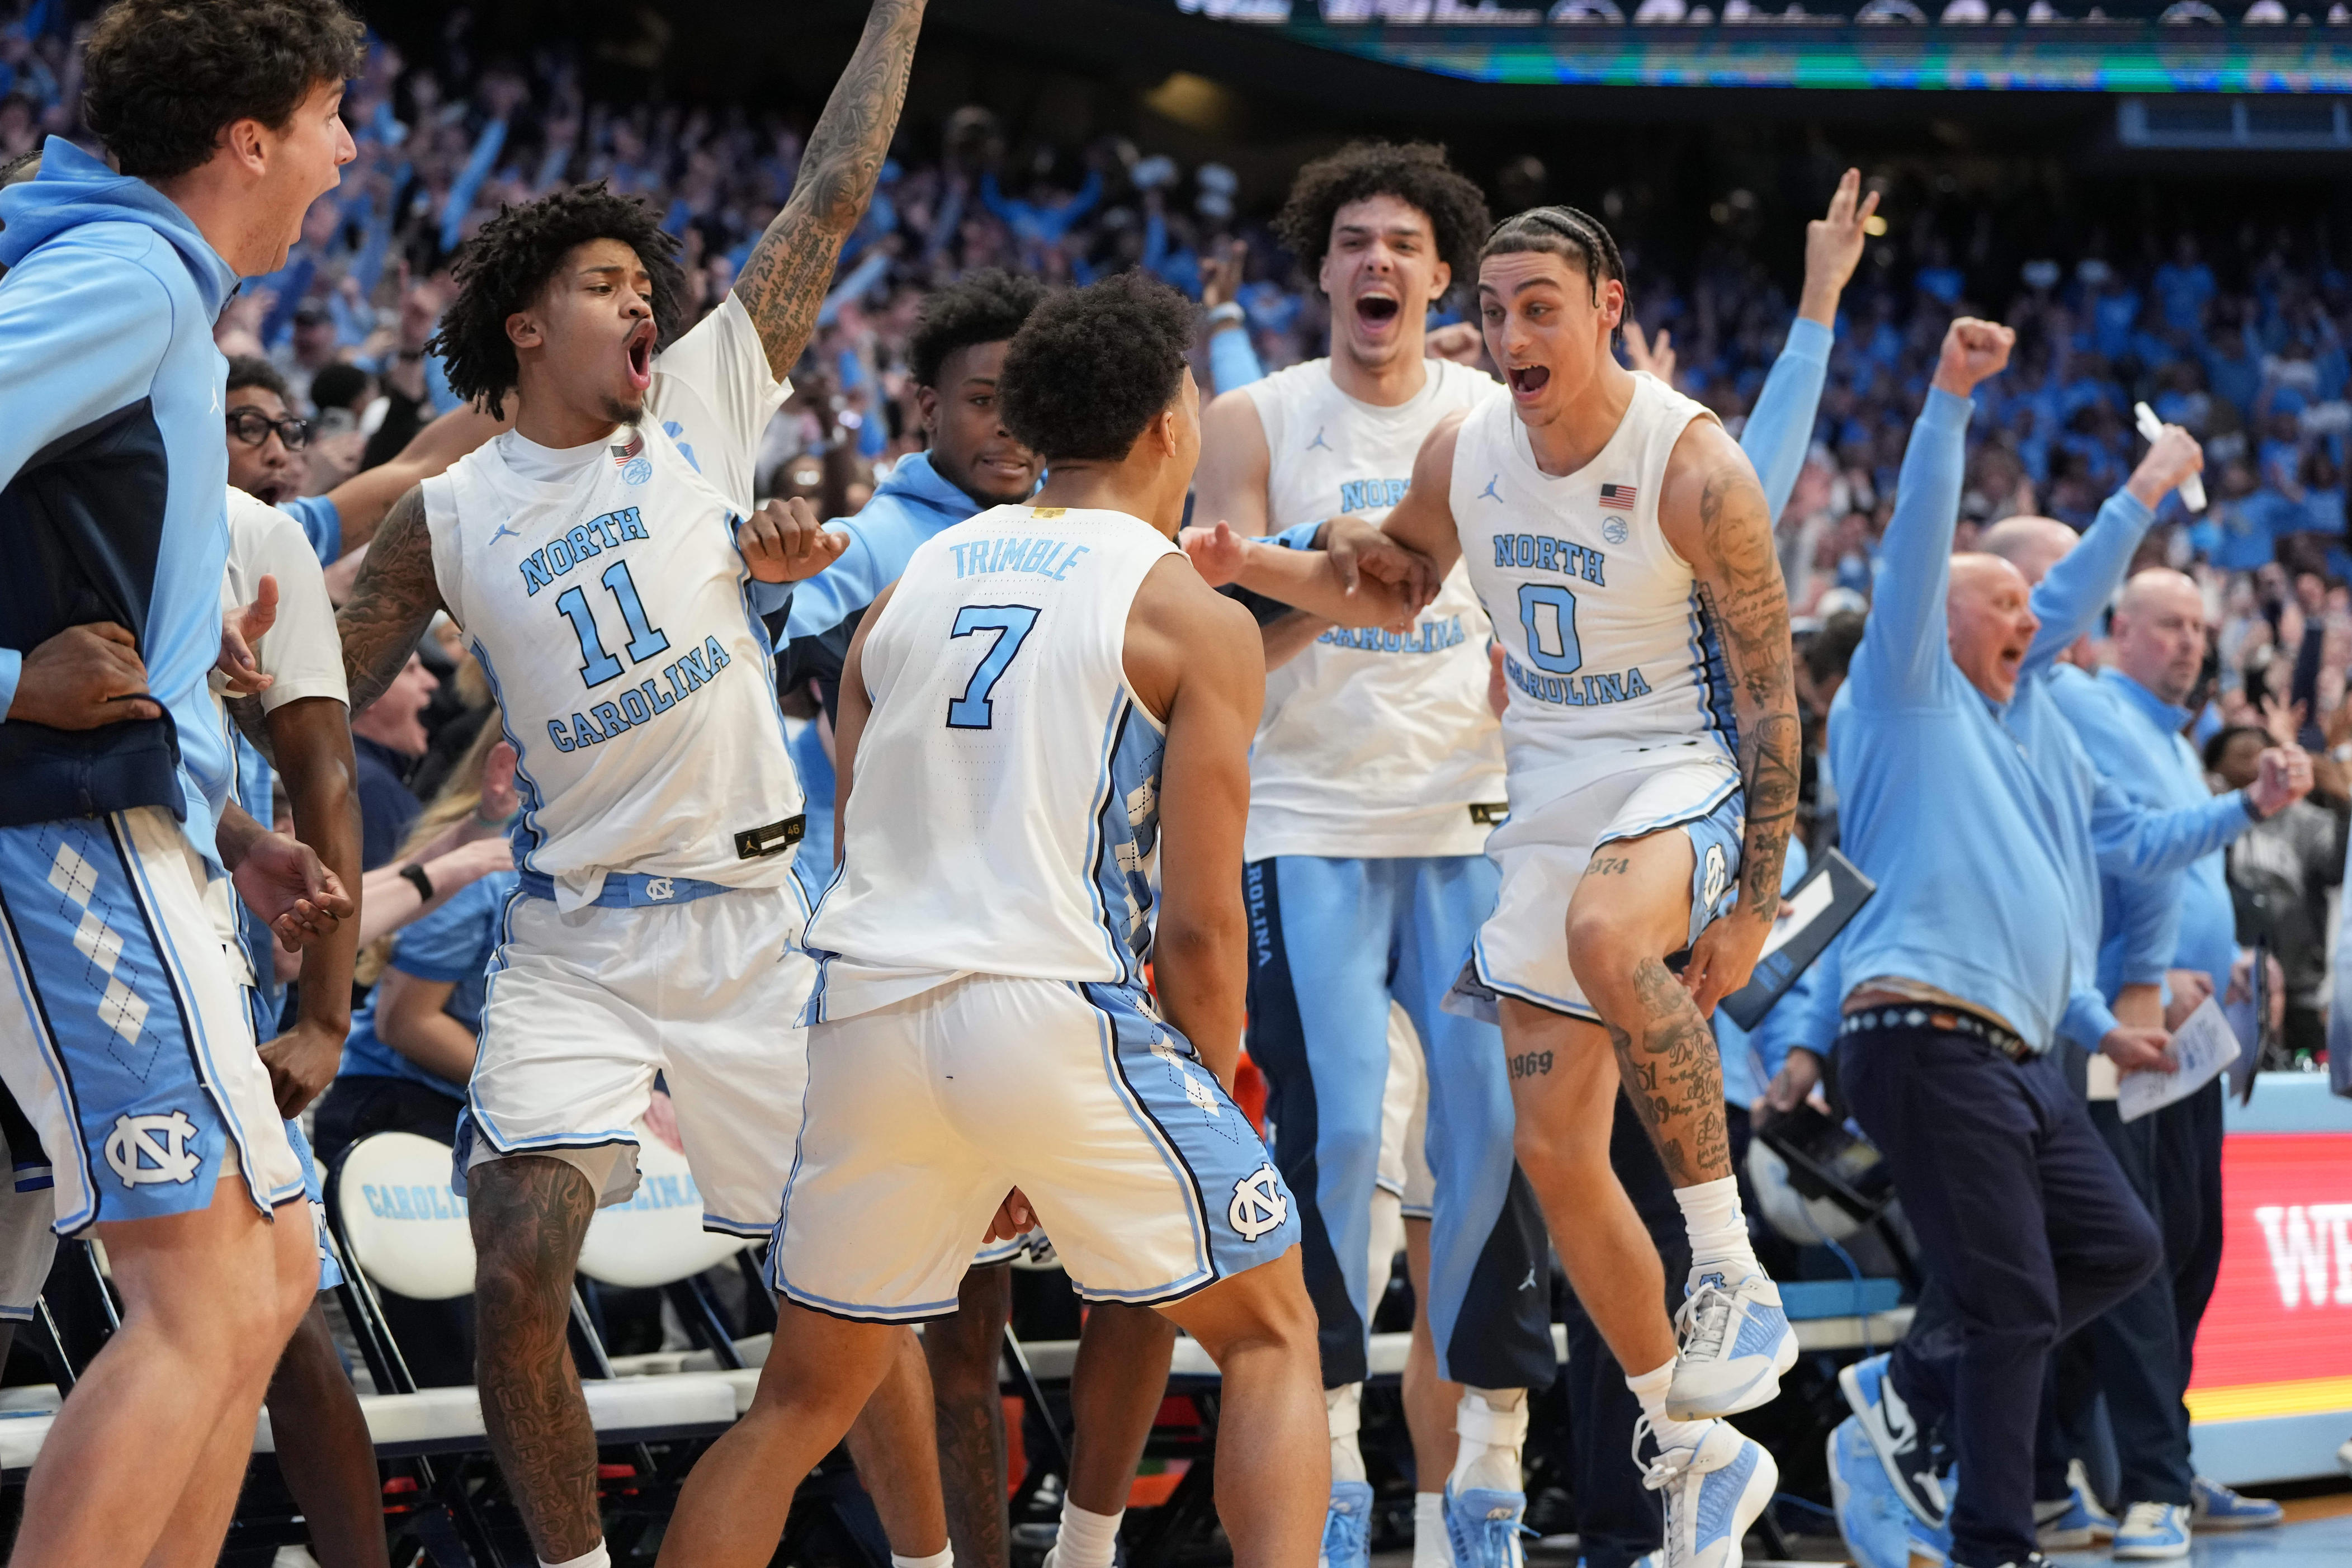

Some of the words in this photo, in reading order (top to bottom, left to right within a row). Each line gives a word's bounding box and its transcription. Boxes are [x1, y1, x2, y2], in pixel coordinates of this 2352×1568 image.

[1340, 479, 1411, 513] NOR
[519, 507, 649, 597] NORTH
[950, 538, 1090, 582] TRIMBLE
[1493, 533, 1605, 587] NORTH
[555, 560, 670, 689] 11
[1518, 583, 1582, 674] 0
[547, 635, 730, 753] CAROLINA
[946, 604, 1042, 730] 7
[787, 824, 800, 835] 46
[1246, 863, 1273, 968] ROLINA
[1508, 1050, 1554, 1080] 1969
[362, 1184, 468, 1220] CAROLI
